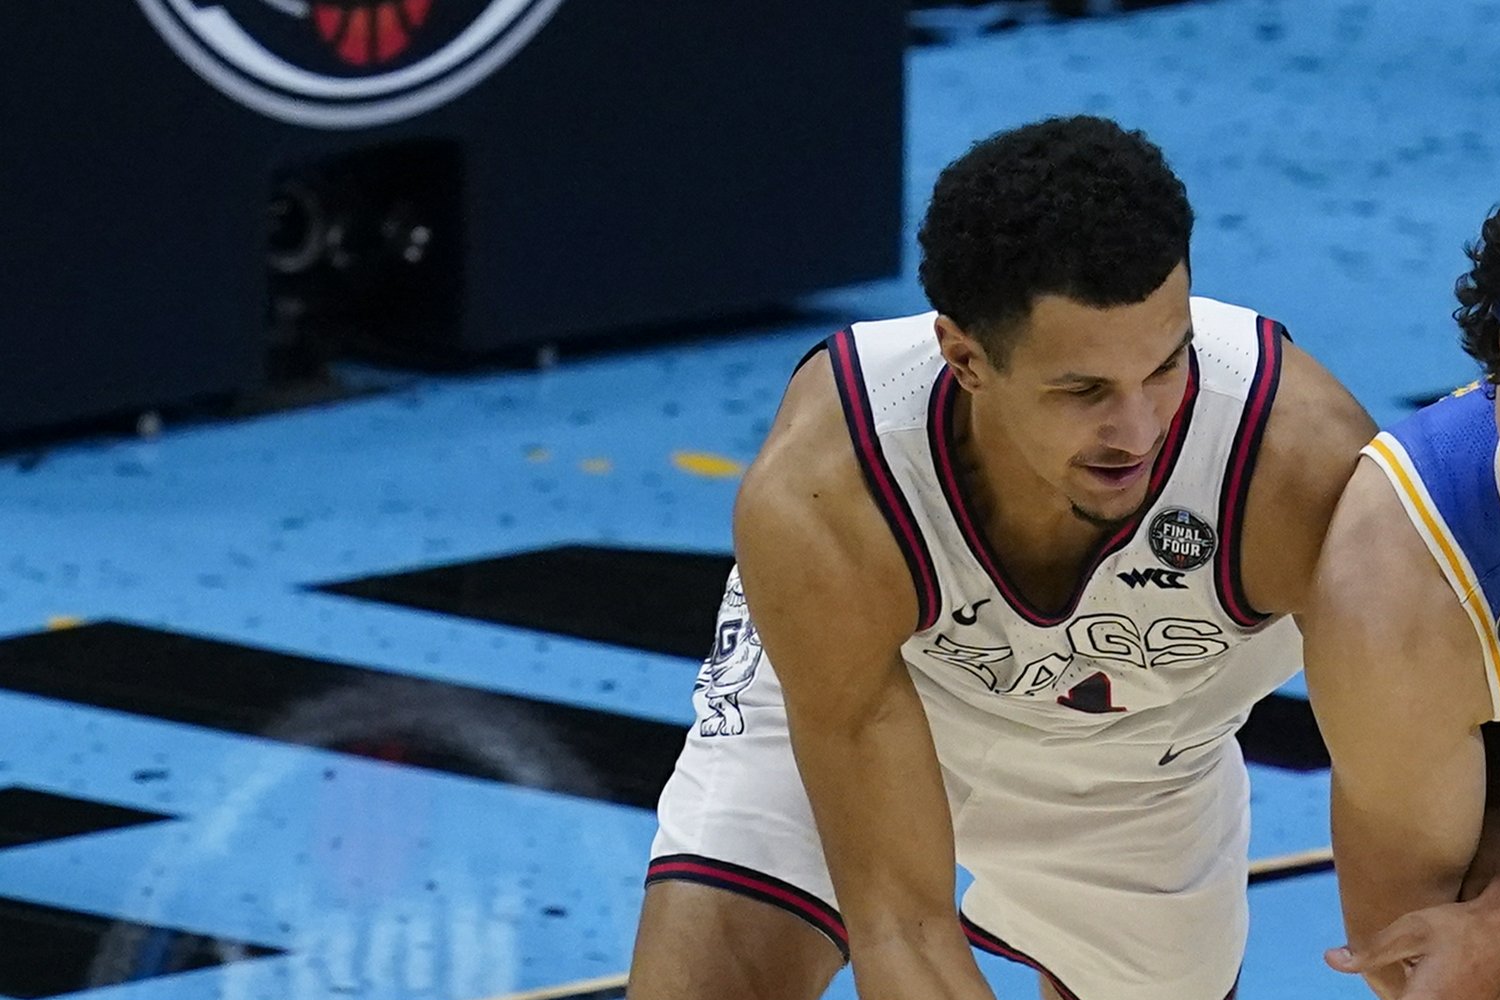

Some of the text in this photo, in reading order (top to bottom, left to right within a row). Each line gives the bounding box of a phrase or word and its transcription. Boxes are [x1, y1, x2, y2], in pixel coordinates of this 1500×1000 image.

[1162, 522, 1202, 542] FINAL
[1161, 538, 1201, 557] FOUR
[1116, 567, 1189, 590] WCC
[923, 612, 1230, 697] ZAGS
